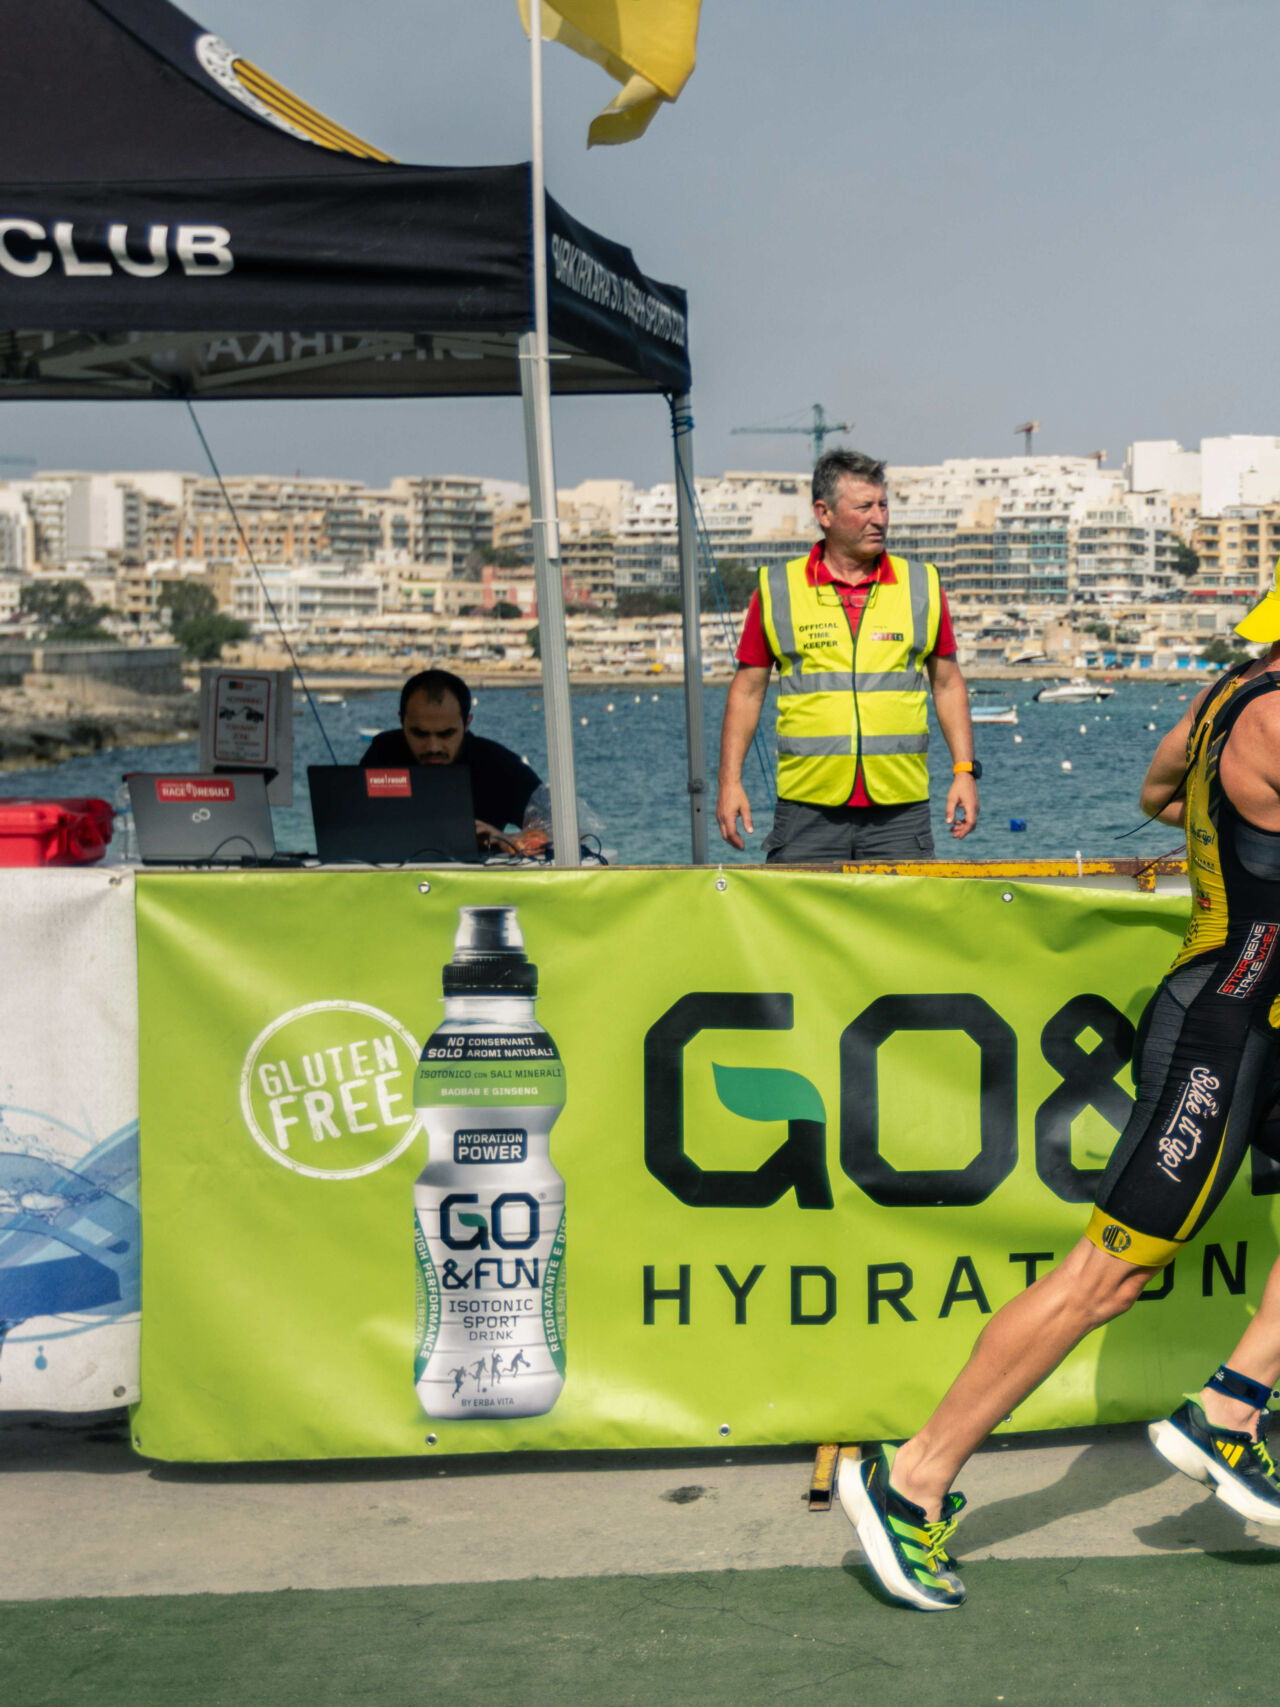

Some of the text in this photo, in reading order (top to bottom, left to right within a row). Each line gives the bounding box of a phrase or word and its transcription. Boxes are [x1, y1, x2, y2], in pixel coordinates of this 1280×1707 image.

[0, 218, 235, 278] CLUB
[799, 622, 839, 632] OFFICIAL
[808, 631, 829, 639] TIME
[803, 640, 838, 650] KEEPER
[1233, 961, 1263, 995] TAKE
[447, 1037, 535, 1047] NO CONSERVANTI
[427, 1048, 555, 1059] SOLO AROMI NATURALI
[258, 1035, 399, 1097] GLUTEN
[419, 1069, 472, 1079] ISOTONICO
[490, 1069, 512, 1078] SALI
[515, 1068, 562, 1078] MINERALI
[440, 1087, 539, 1096] BAOBAB E GINSENG
[1186, 1067, 1220, 1115] Bike
[268, 1070, 413, 1151] FREE
[458, 1133, 523, 1144] HYDRATION
[458, 1145, 522, 1160] POWER
[439, 1192, 540, 1251] GO
[441, 1257, 540, 1290] &FUN
[643, 1241, 1247, 1326] HYDRATN
[449, 1299, 533, 1313] ISOTONIC
[544, 1259, 560, 1352] REIDRATANTE
[553, 1247, 562, 1256] E
[420, 1262, 438, 1359] PERFORMANCE
[463, 1315, 519, 1328] SPORT
[469, 1330, 513, 1340] DRINK
[461, 1397, 515, 1407] BY ERBA VITA
